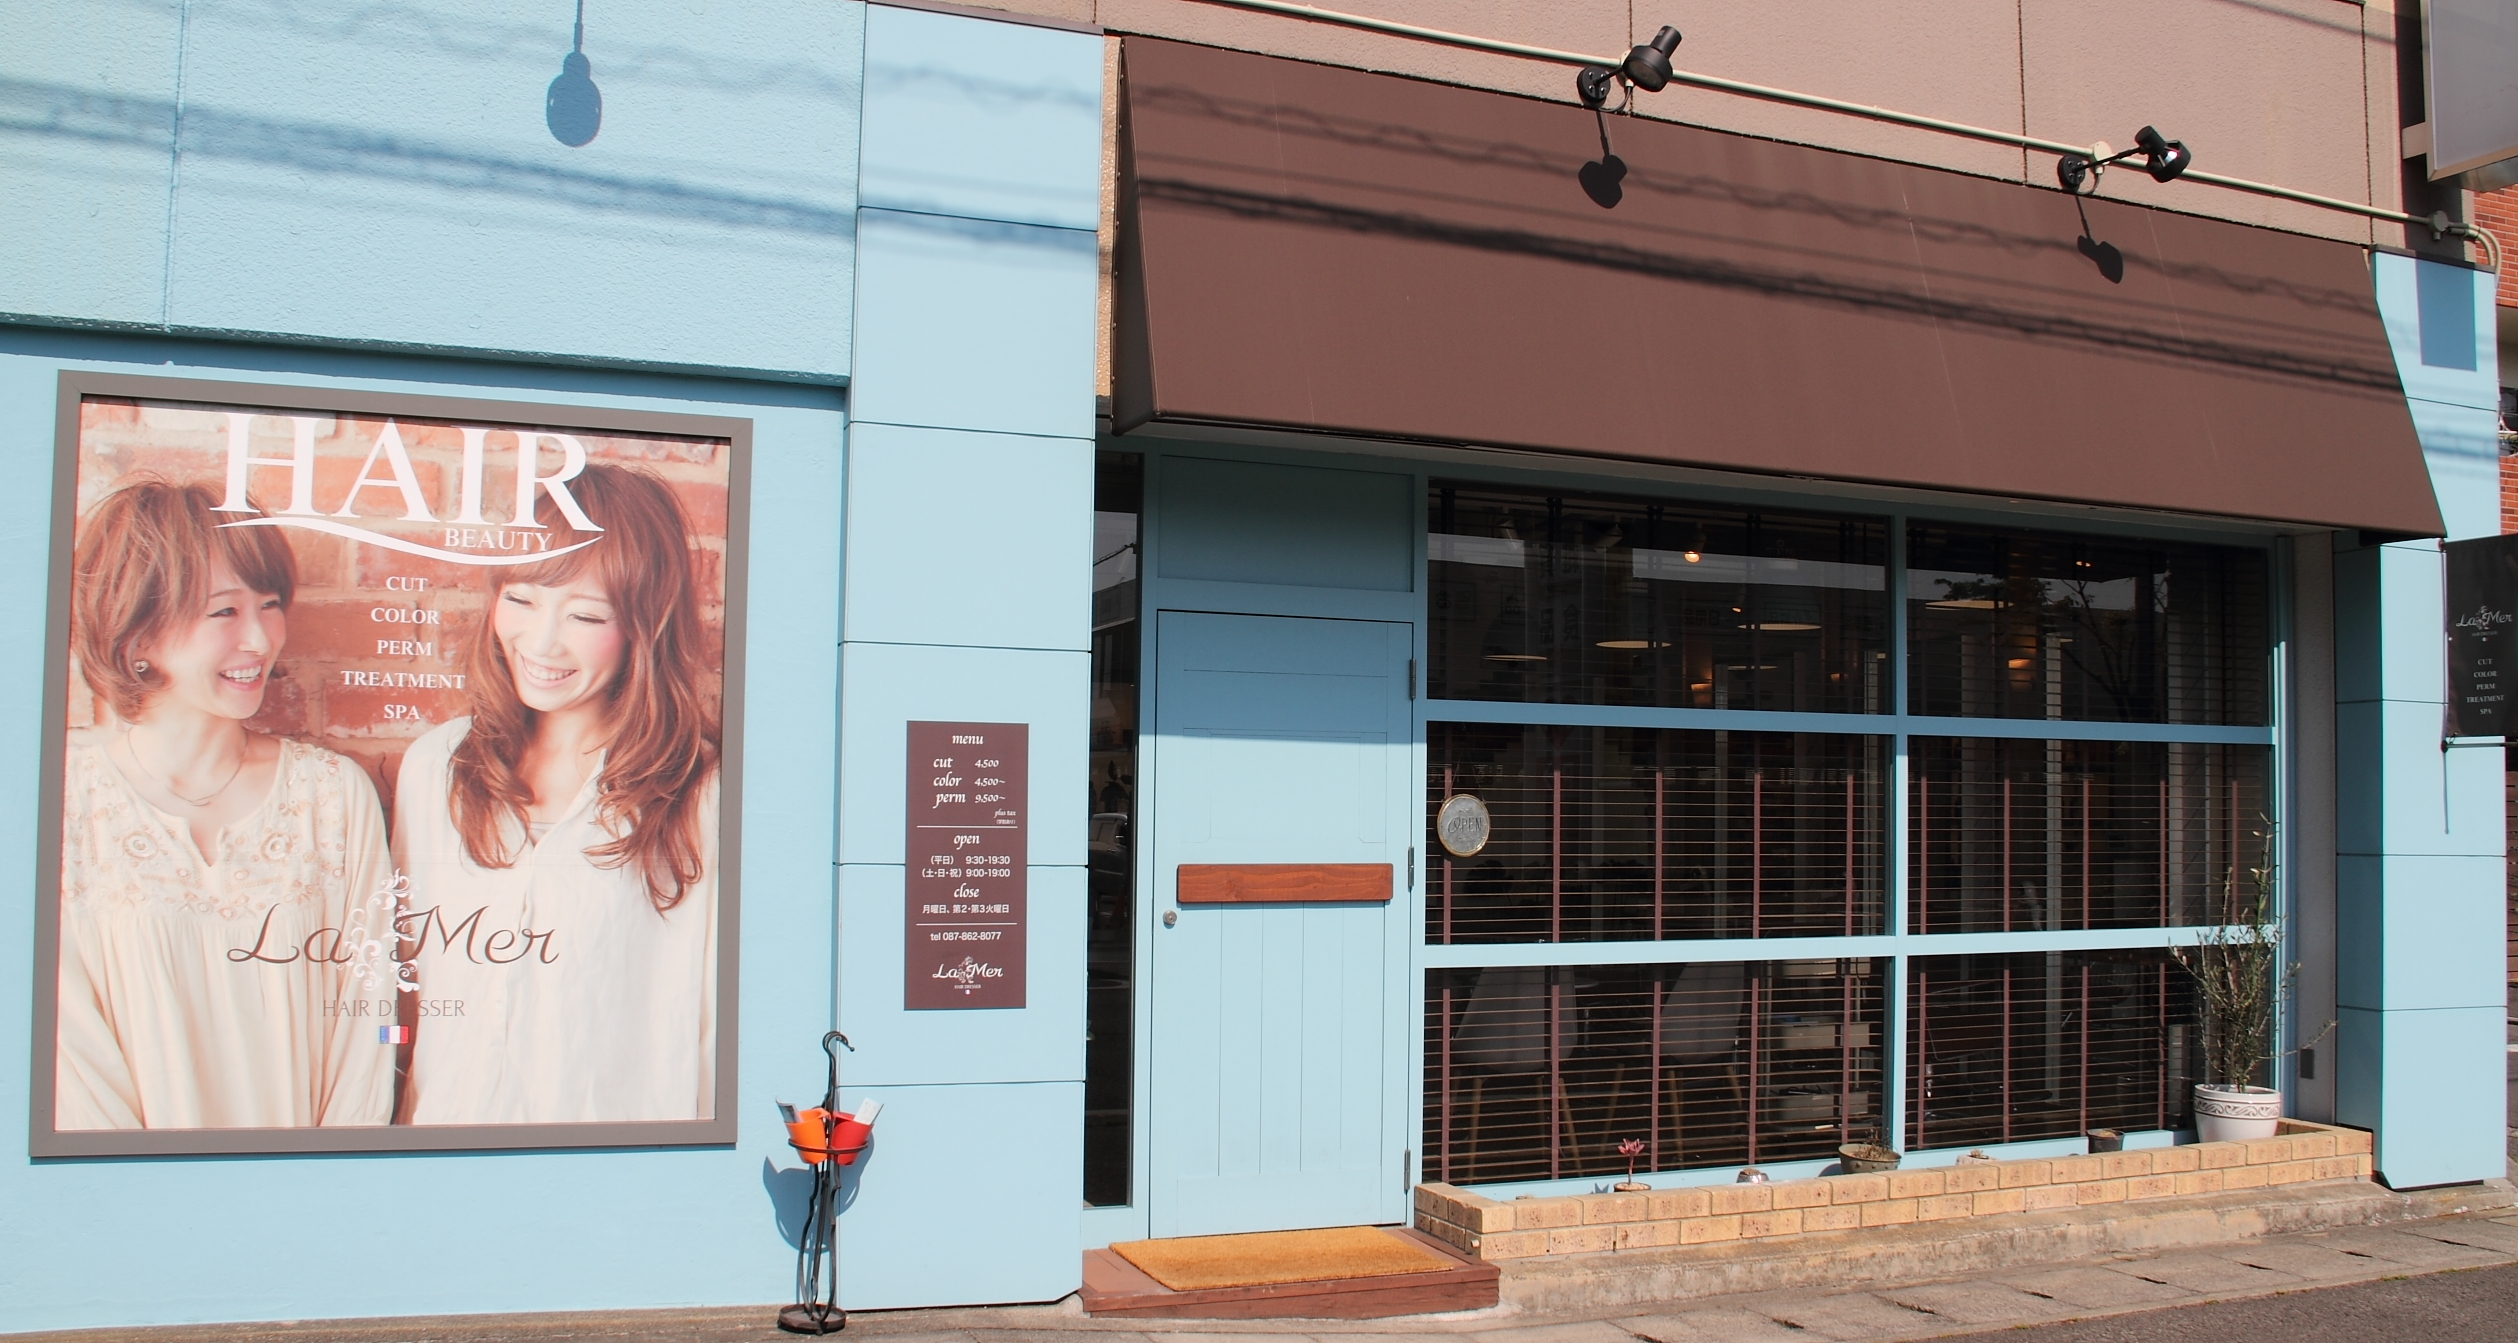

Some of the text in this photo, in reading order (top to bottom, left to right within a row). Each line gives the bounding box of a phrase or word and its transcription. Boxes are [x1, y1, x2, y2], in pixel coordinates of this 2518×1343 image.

[208, 412, 605, 532] HAIR
[444, 528, 553, 552] BEAUTY
[385, 576, 428, 592] CUT
[370, 607, 440, 625] COLOR
[2455, 614, 2478, 627] La
[376, 639, 432, 656] PERM
[340, 670, 466, 689] TREATMENT
[383, 704, 420, 720] SPA
[951, 734, 984, 745] menu
[933, 757, 953, 768] cut
[933, 771, 962, 787] color
[932, 793, 967, 809] perm
[1447, 816, 1482, 834] OPEN
[953, 834, 981, 851] open
[965, 855, 1011, 865] 9:30-19:30
[965, 868, 1011, 878] 9:00-19:00
[953, 882, 980, 898] close
[227, 903, 560, 965] La Mer
[929, 931, 1002, 941] tel 087-862-8077
[931, 962, 1004, 979] La Mer
[322, 1000, 371, 1017] HAIR
